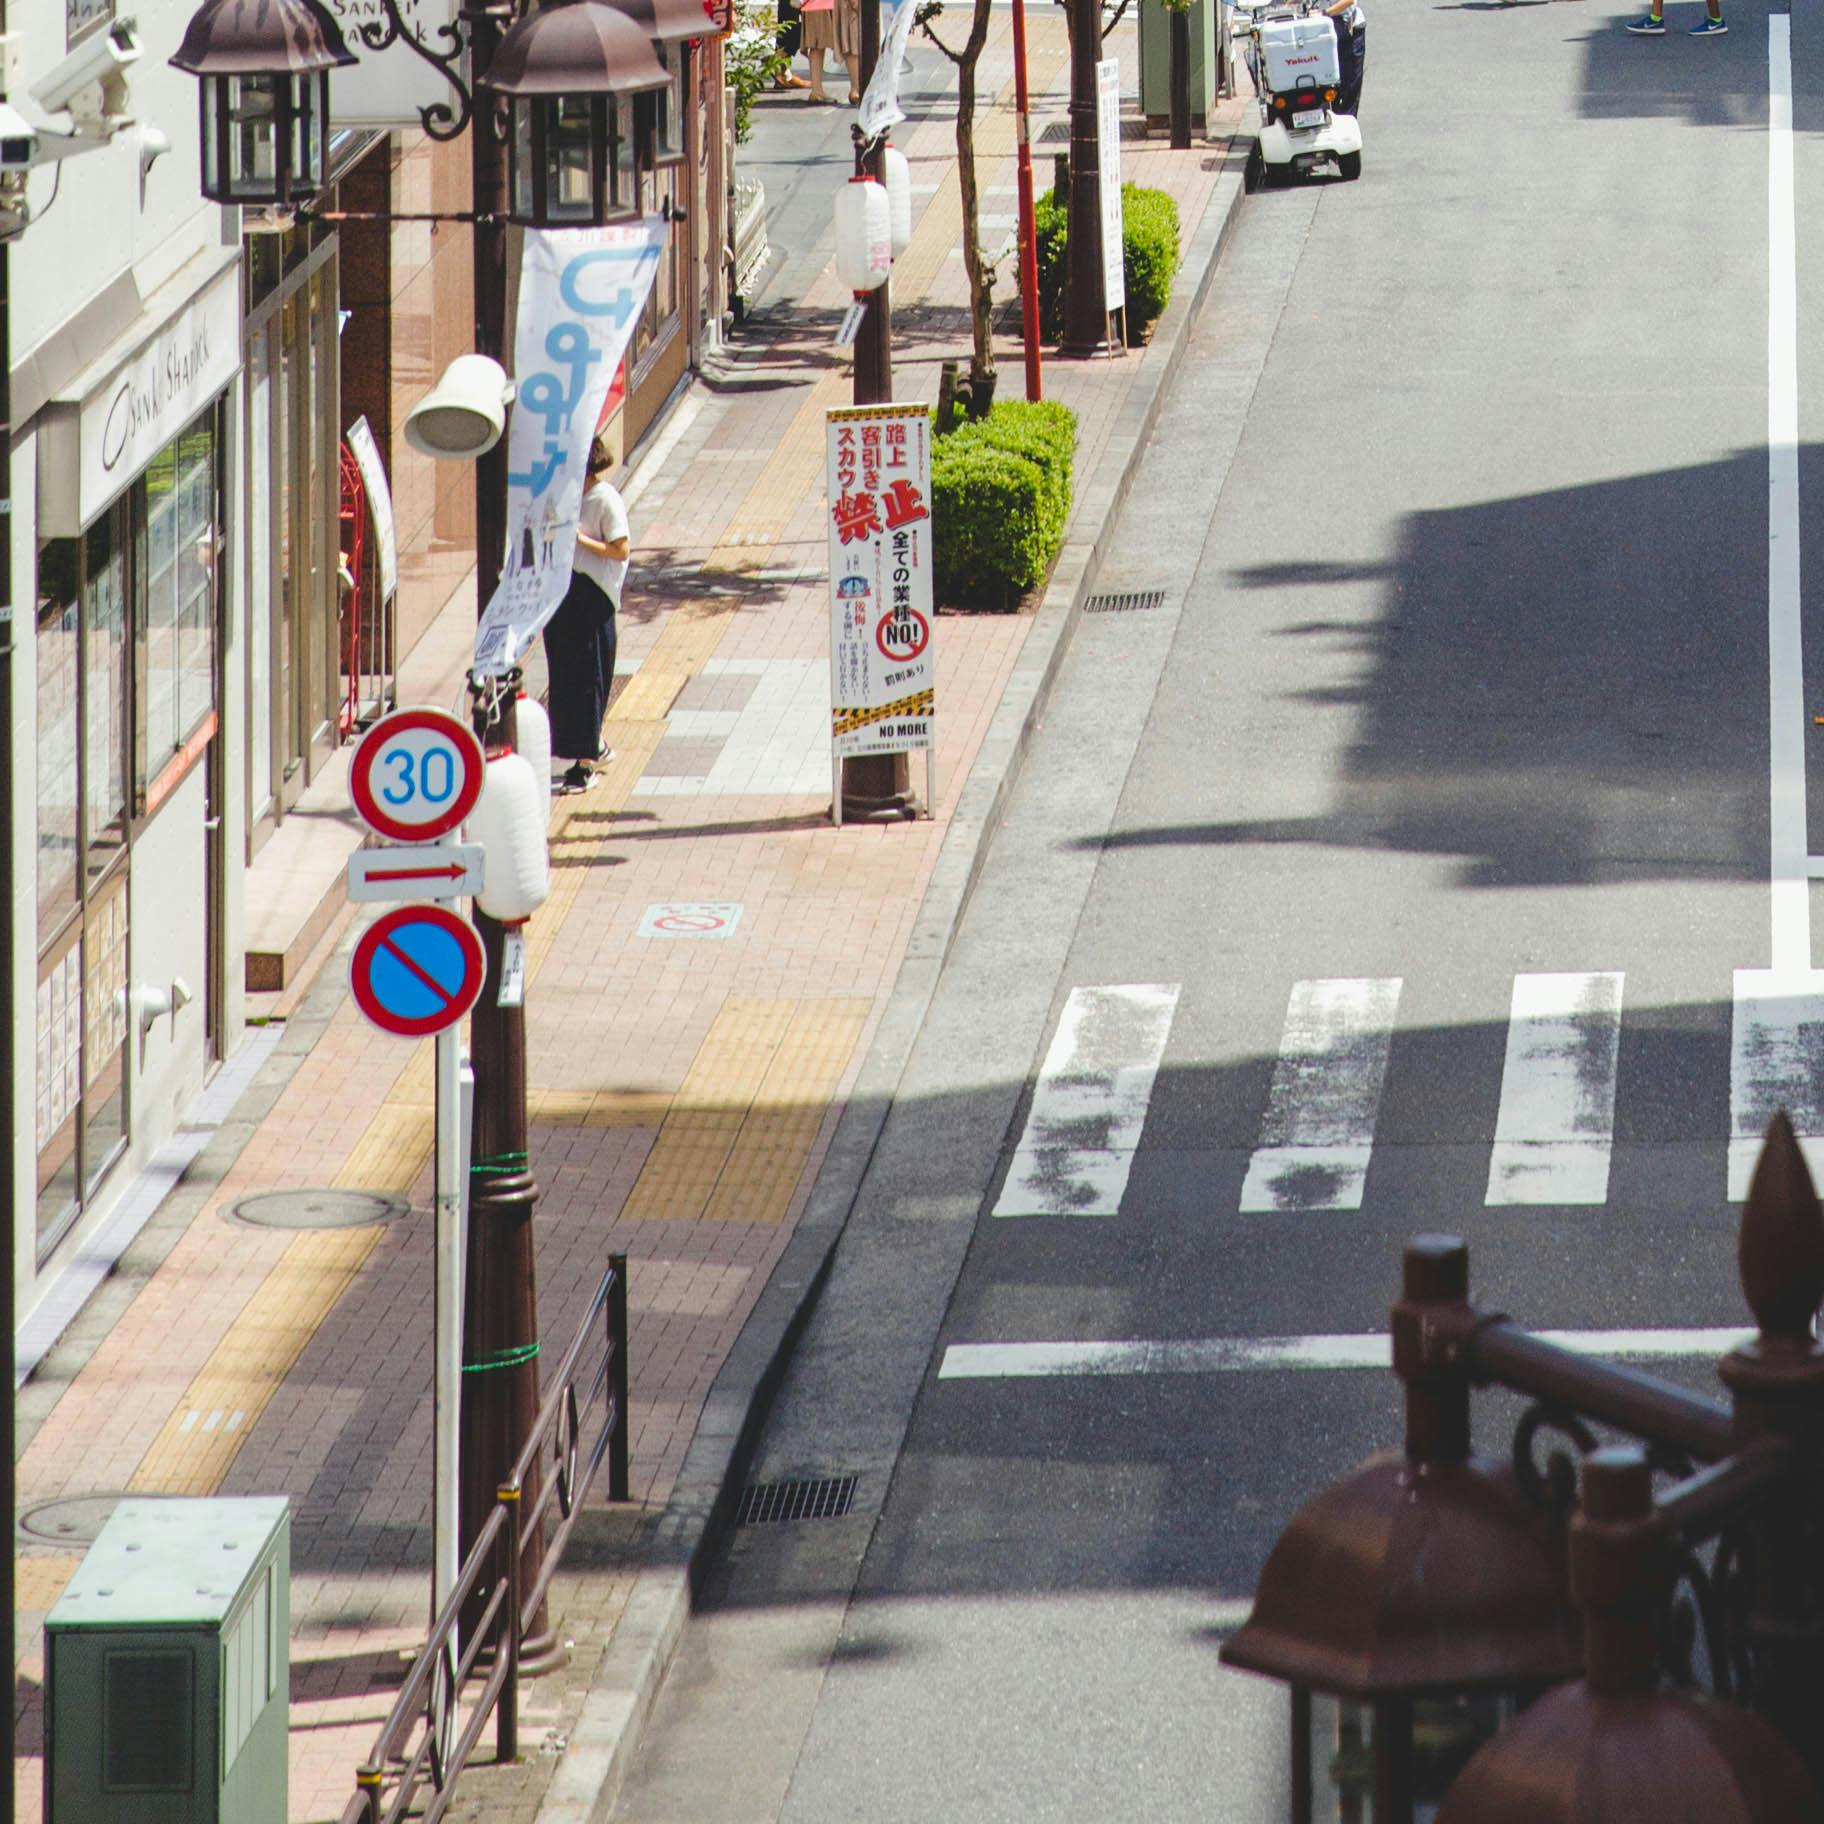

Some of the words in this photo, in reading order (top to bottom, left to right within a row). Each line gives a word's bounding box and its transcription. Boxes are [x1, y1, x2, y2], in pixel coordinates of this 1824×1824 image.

[879, 722, 895, 739] NO
[896, 721, 928, 737] MORE
[382, 746, 455, 806] 30
